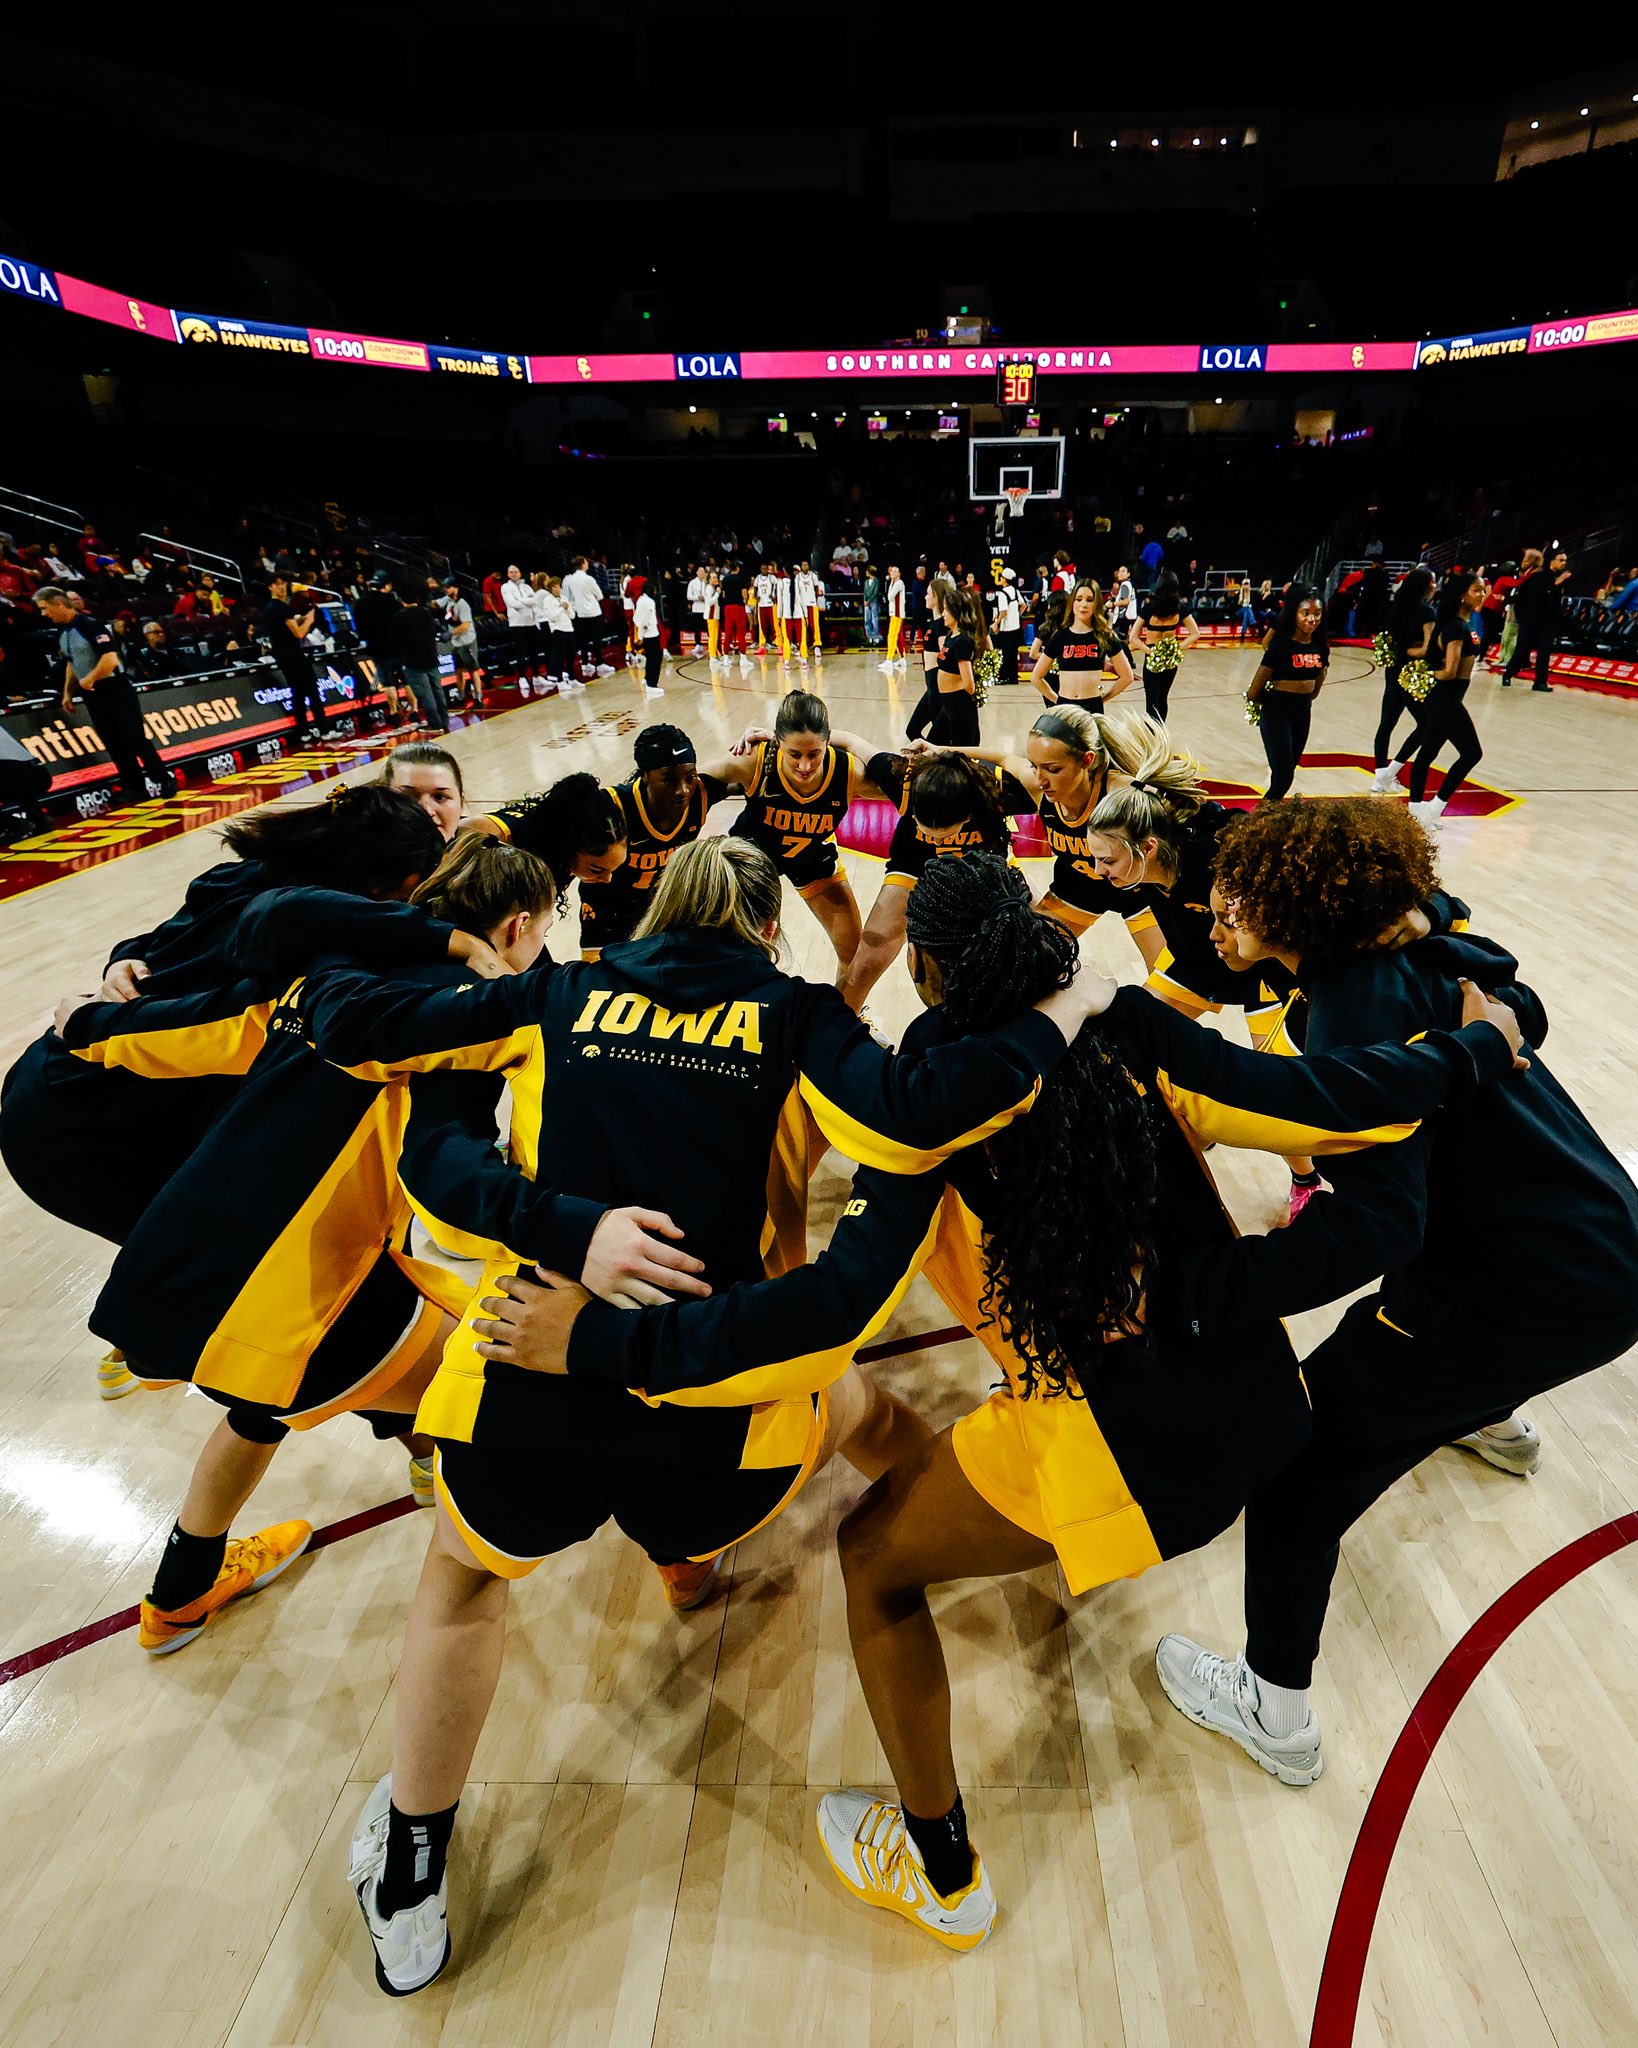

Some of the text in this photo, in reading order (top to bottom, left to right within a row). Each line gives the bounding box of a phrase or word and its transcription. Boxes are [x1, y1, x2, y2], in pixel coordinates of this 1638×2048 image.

[220, 331, 309, 354] HAWKEYES
[1534, 324, 1585, 348] 10:00
[314, 337, 364, 358] 10:00
[1202, 348, 1261, 368] LOLA
[1449, 338, 1527, 361] HAWKEYES
[437, 357, 499, 376] TROJANS
[677, 356, 737, 377] LOLA
[826, 354, 951, 371] SOUTHERN
[1005, 365, 1034, 378] 10:00
[1004, 379, 1029, 401] 30
[989, 546, 1010, 555] YETI
[1062, 644, 1098, 659] USC
[1292, 653, 1323, 669] USC
[207, 752, 235, 770] ARCO
[764, 806, 834, 834] IOWA
[781, 835, 812, 858] 7
[1047, 828, 1093, 857] IOW
[571, 990, 764, 1055] IOWA
[609, 1052, 662, 1065] HAWKEYE
[610, 1046, 747, 1073] ENGINEERED FOR
